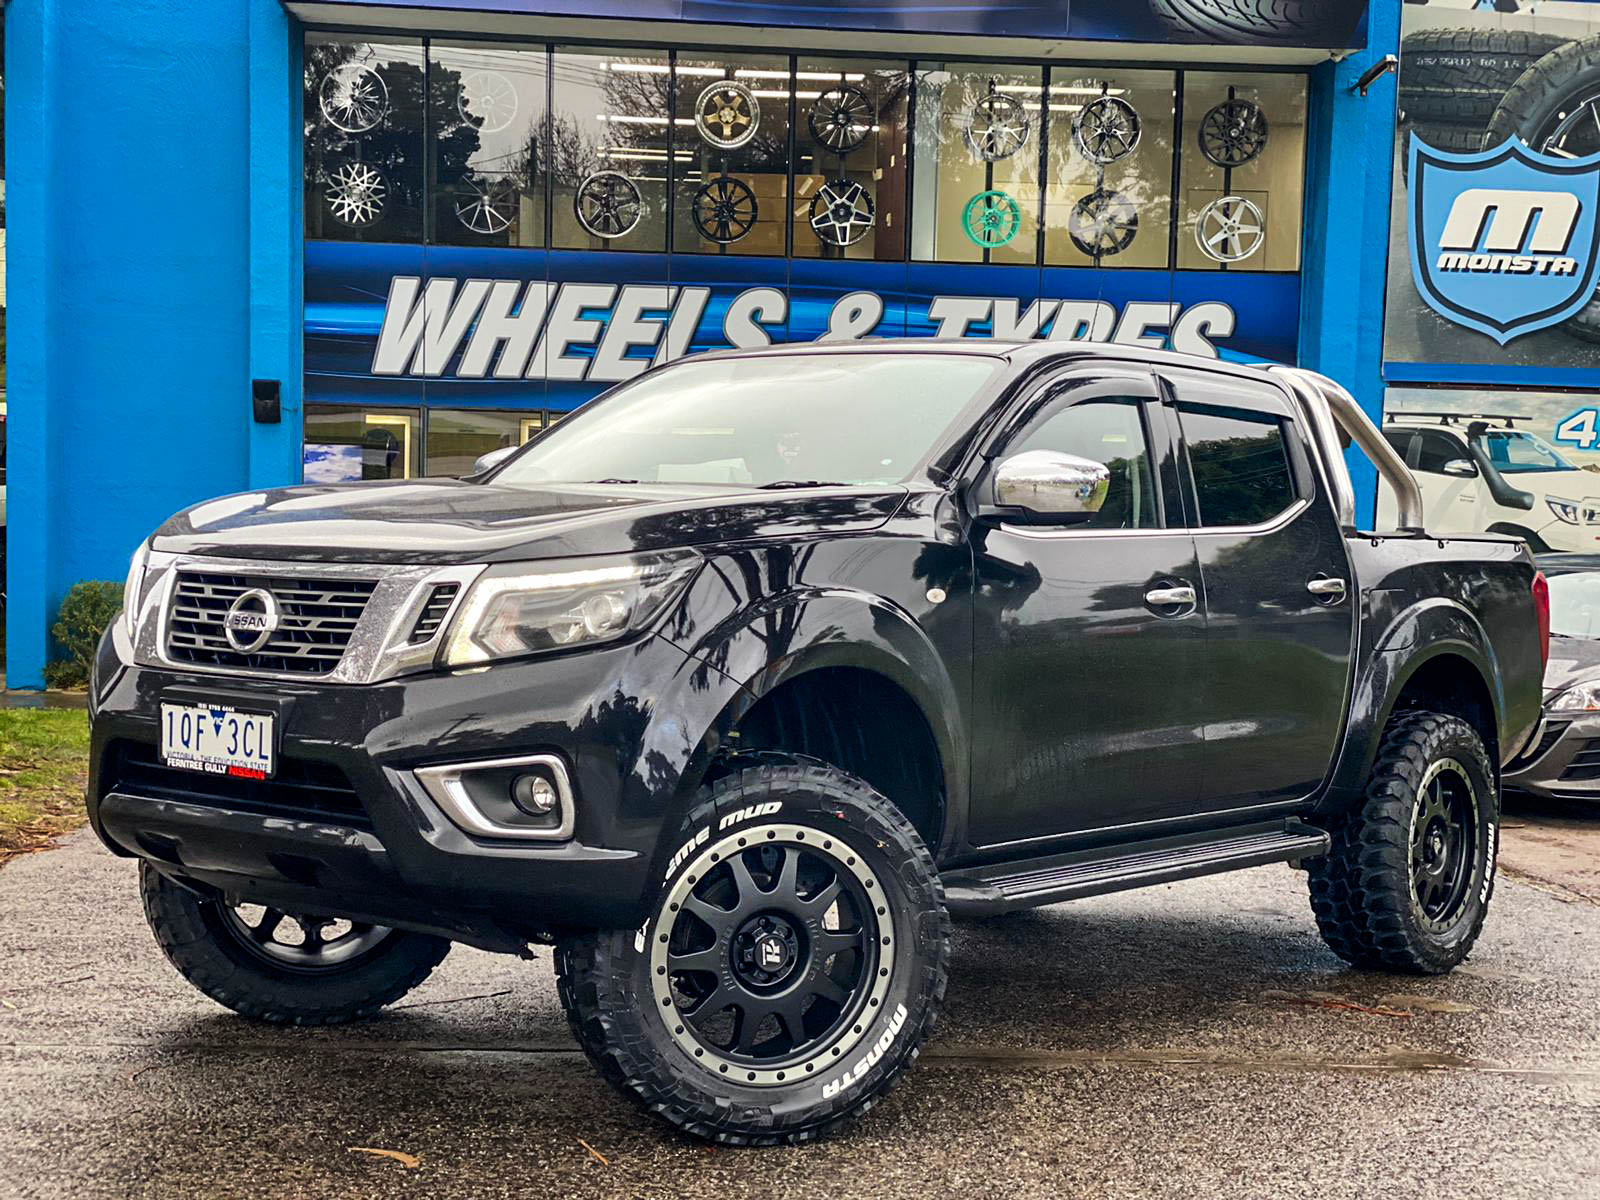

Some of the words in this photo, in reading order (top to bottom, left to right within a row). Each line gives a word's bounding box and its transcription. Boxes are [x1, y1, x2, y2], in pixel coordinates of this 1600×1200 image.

[1436, 253, 1579, 277] MONSTA
[371, 275, 788, 381] WHEELS
[814, 290, 884, 341] &
[1556, 407, 1600, 449] 4
[167, 711, 207, 752] 1QF
[227, 718, 269, 760] 3CL
[167, 757, 204, 772] FERNTREE
[204, 762, 227, 774] GULLY
[228, 765, 266, 780] NISSAN
[719, 801, 783, 831] MUD
[1479, 822, 1495, 904] MONSTA
[822, 1002, 908, 1099] MONSTA
